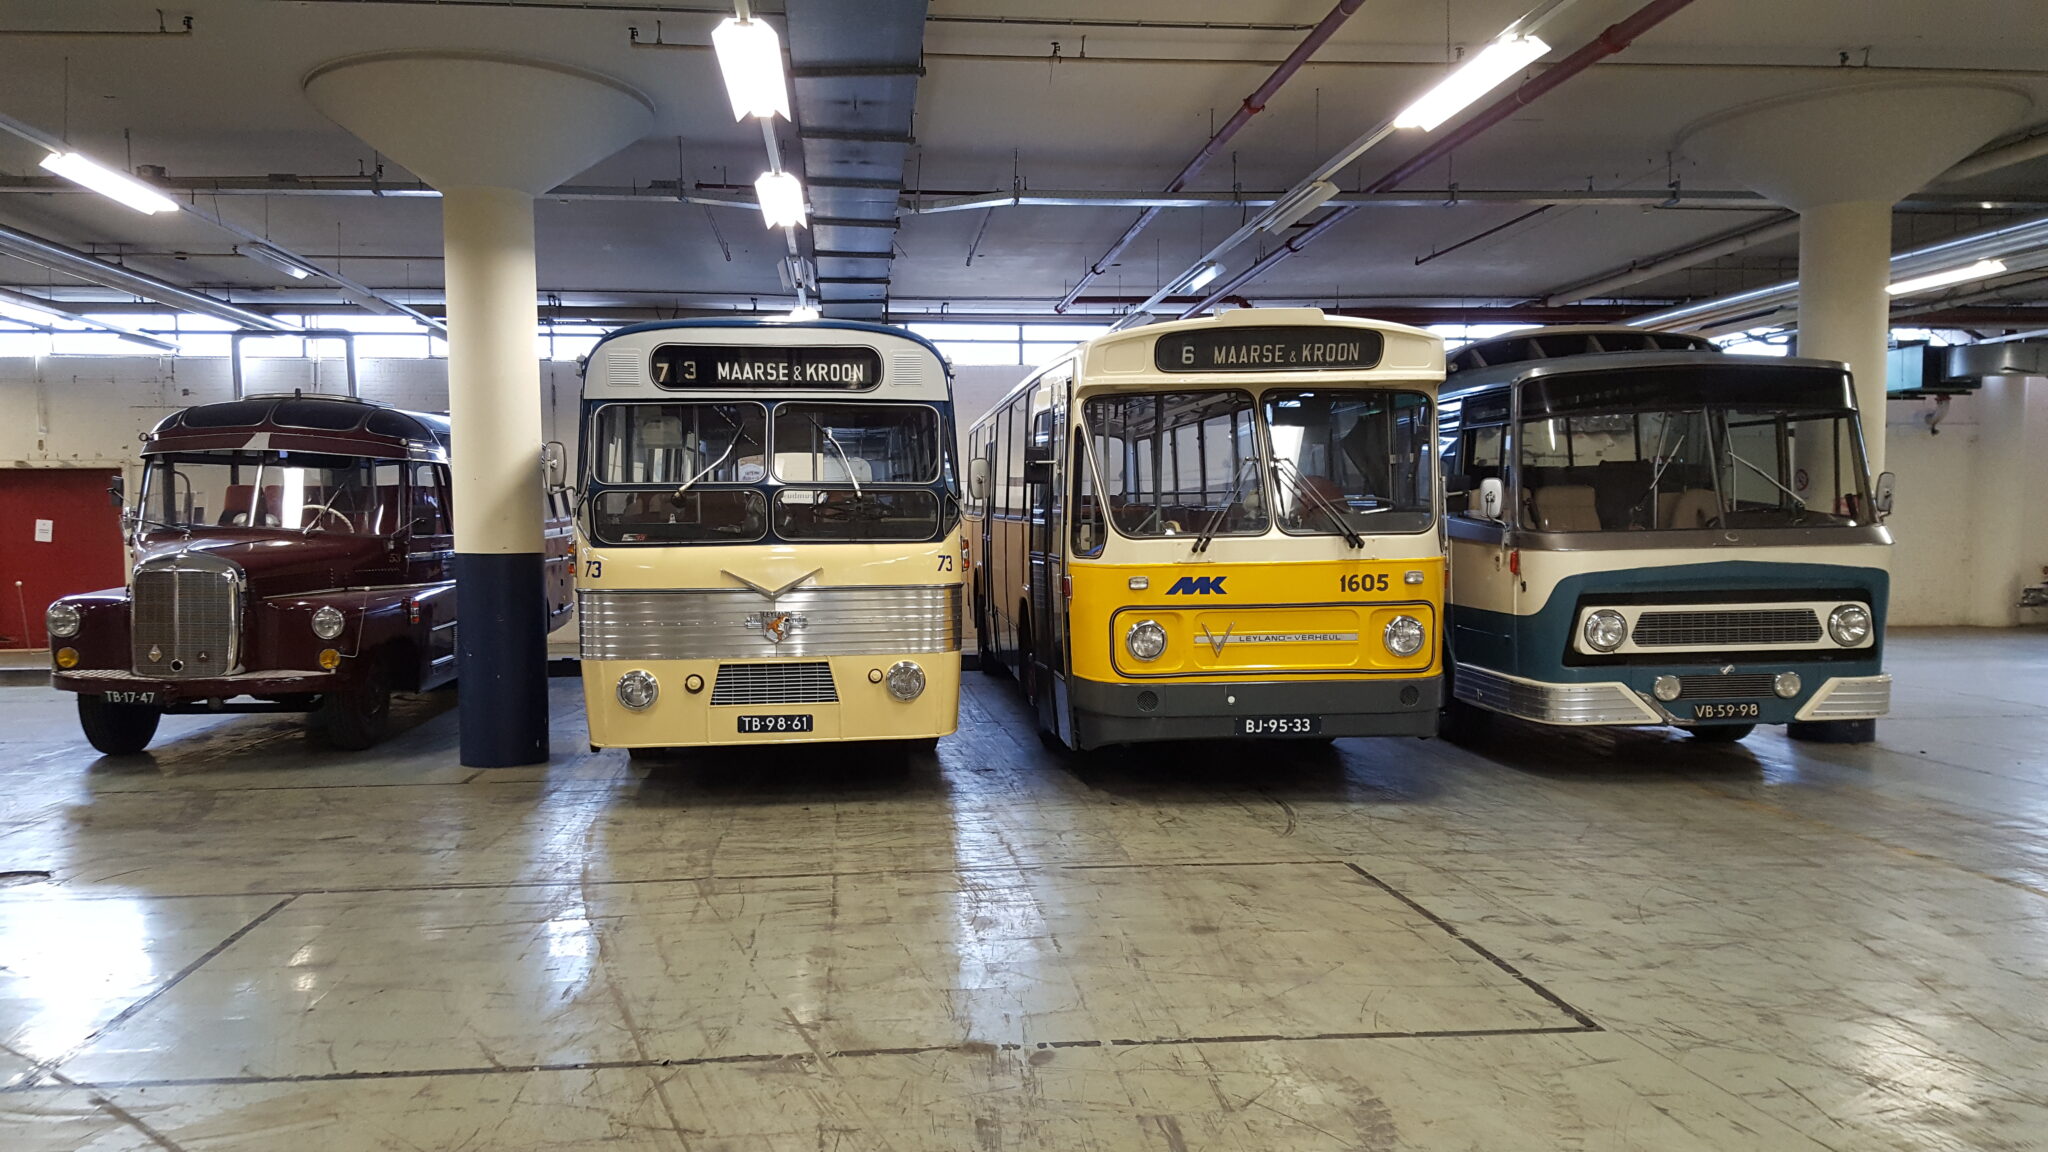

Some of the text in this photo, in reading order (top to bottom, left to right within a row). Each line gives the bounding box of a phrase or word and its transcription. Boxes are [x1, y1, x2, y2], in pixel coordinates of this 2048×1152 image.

[1181, 343, 1360, 364] 6 MAARSE & KROON
[717, 362, 789, 381] MAARSE
[793, 366, 802, 381] &
[805, 363, 864, 382] KROON
[585, 560, 602, 578] 73
[937, 554, 953, 571] 73
[1165, 576, 1228, 595] MK
[1340, 574, 1389, 592] 1605
[104, 690, 155, 703] TB-17-47
[1694, 703, 1758, 718] VB-59-98
[1245, 718, 1311, 733] BJ-95-33
